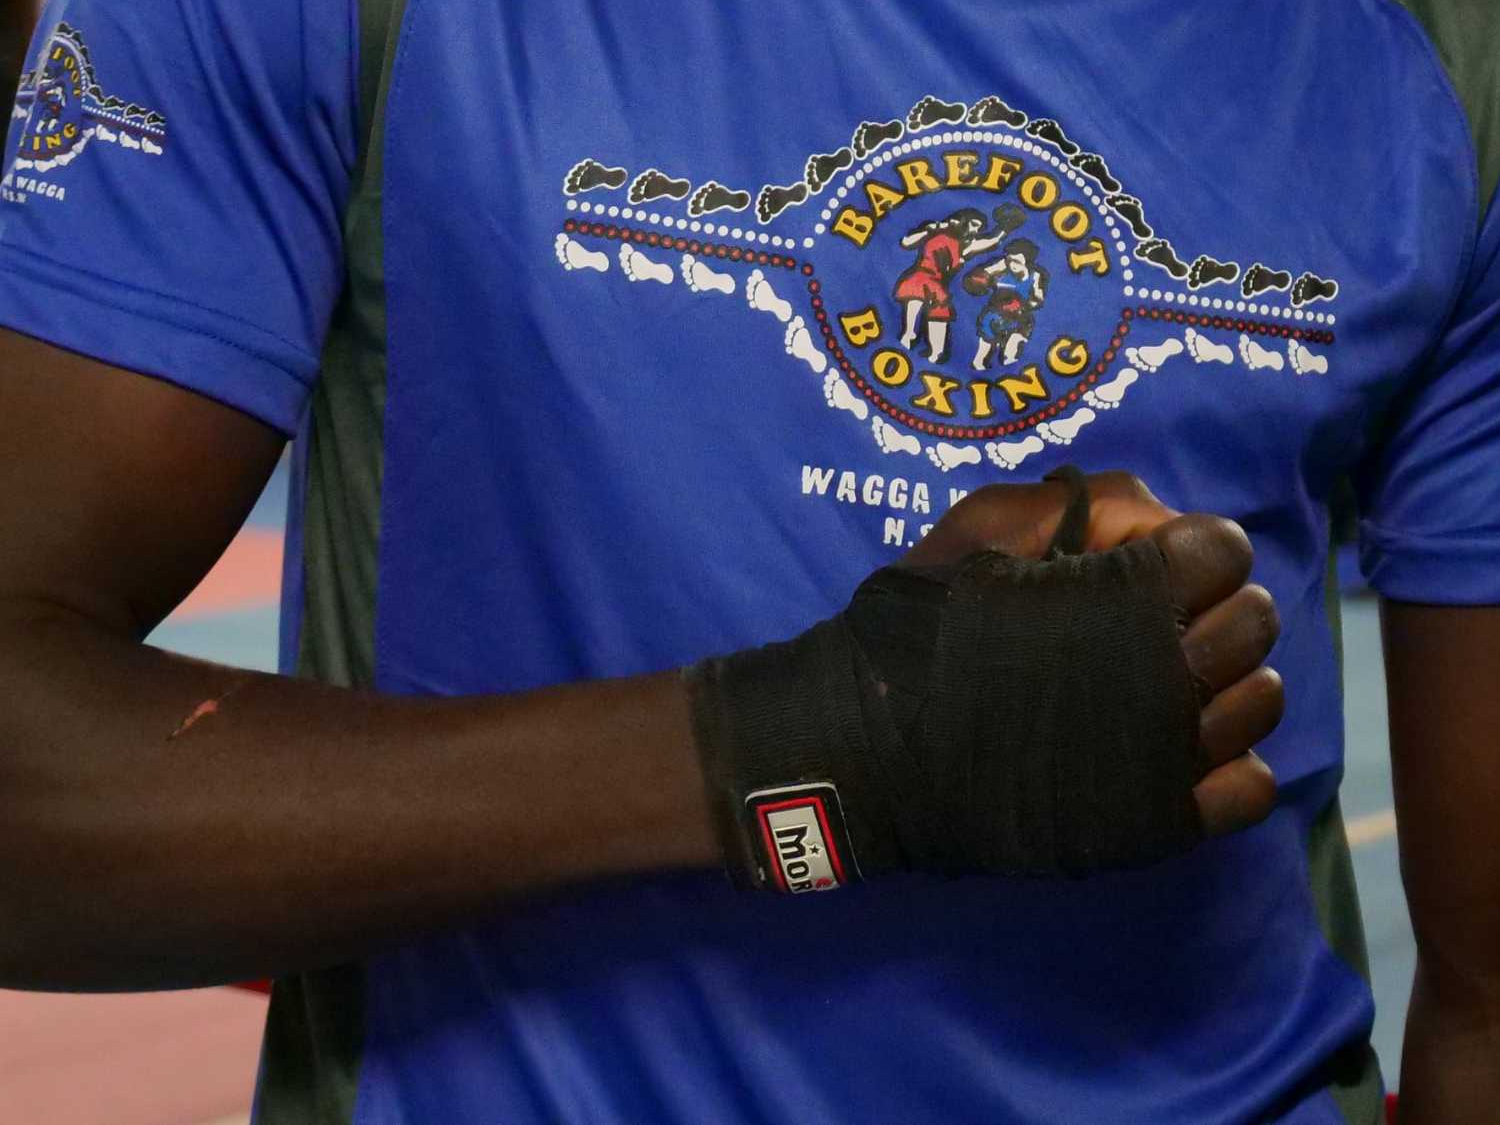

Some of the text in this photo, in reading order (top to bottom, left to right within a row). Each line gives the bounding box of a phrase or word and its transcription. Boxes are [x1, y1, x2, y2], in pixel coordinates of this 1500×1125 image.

[832, 151, 1111, 277] BAREFOOT
[839, 308, 1091, 418] BOXING
[802, 465, 930, 513] WAGGA
